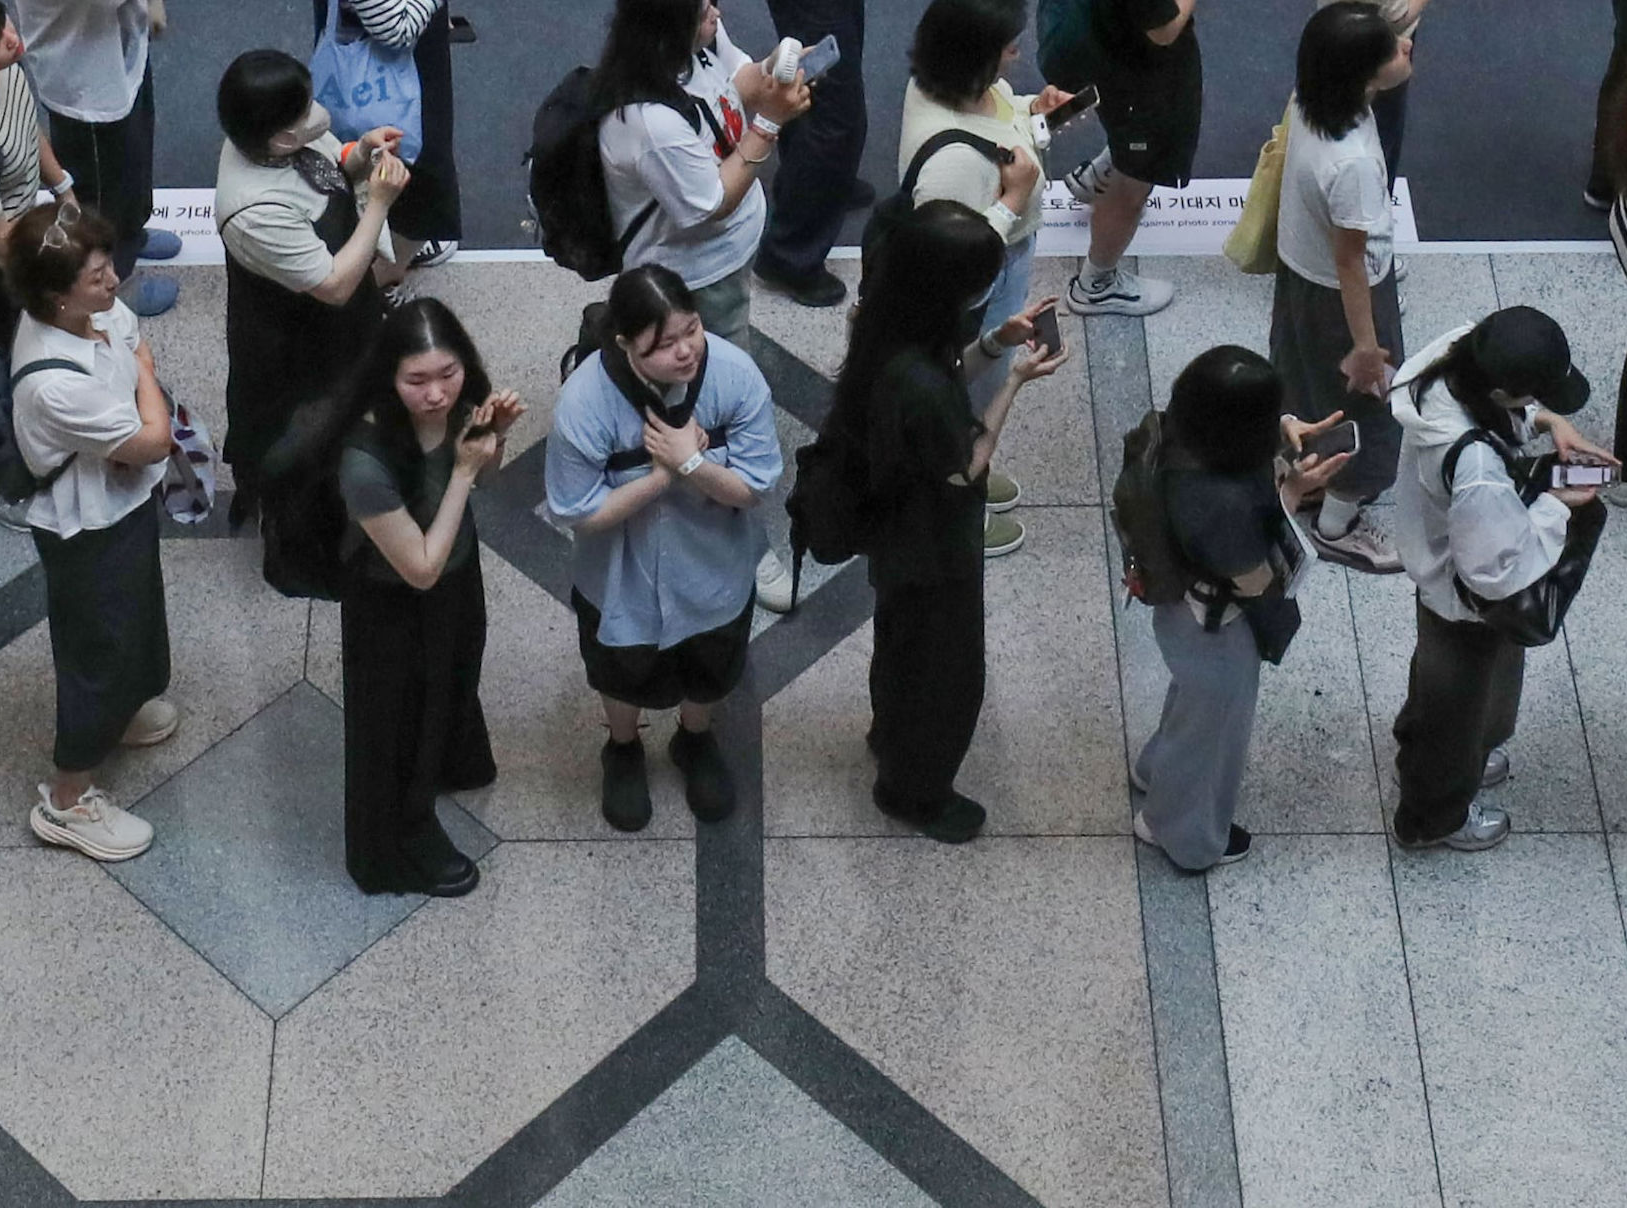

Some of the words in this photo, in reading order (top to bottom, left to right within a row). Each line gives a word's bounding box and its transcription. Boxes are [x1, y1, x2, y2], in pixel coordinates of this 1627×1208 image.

[1169, 196, 1221, 210] 기대지
[175, 205, 216, 219] 기대
[1177, 219, 1209, 228] photo
